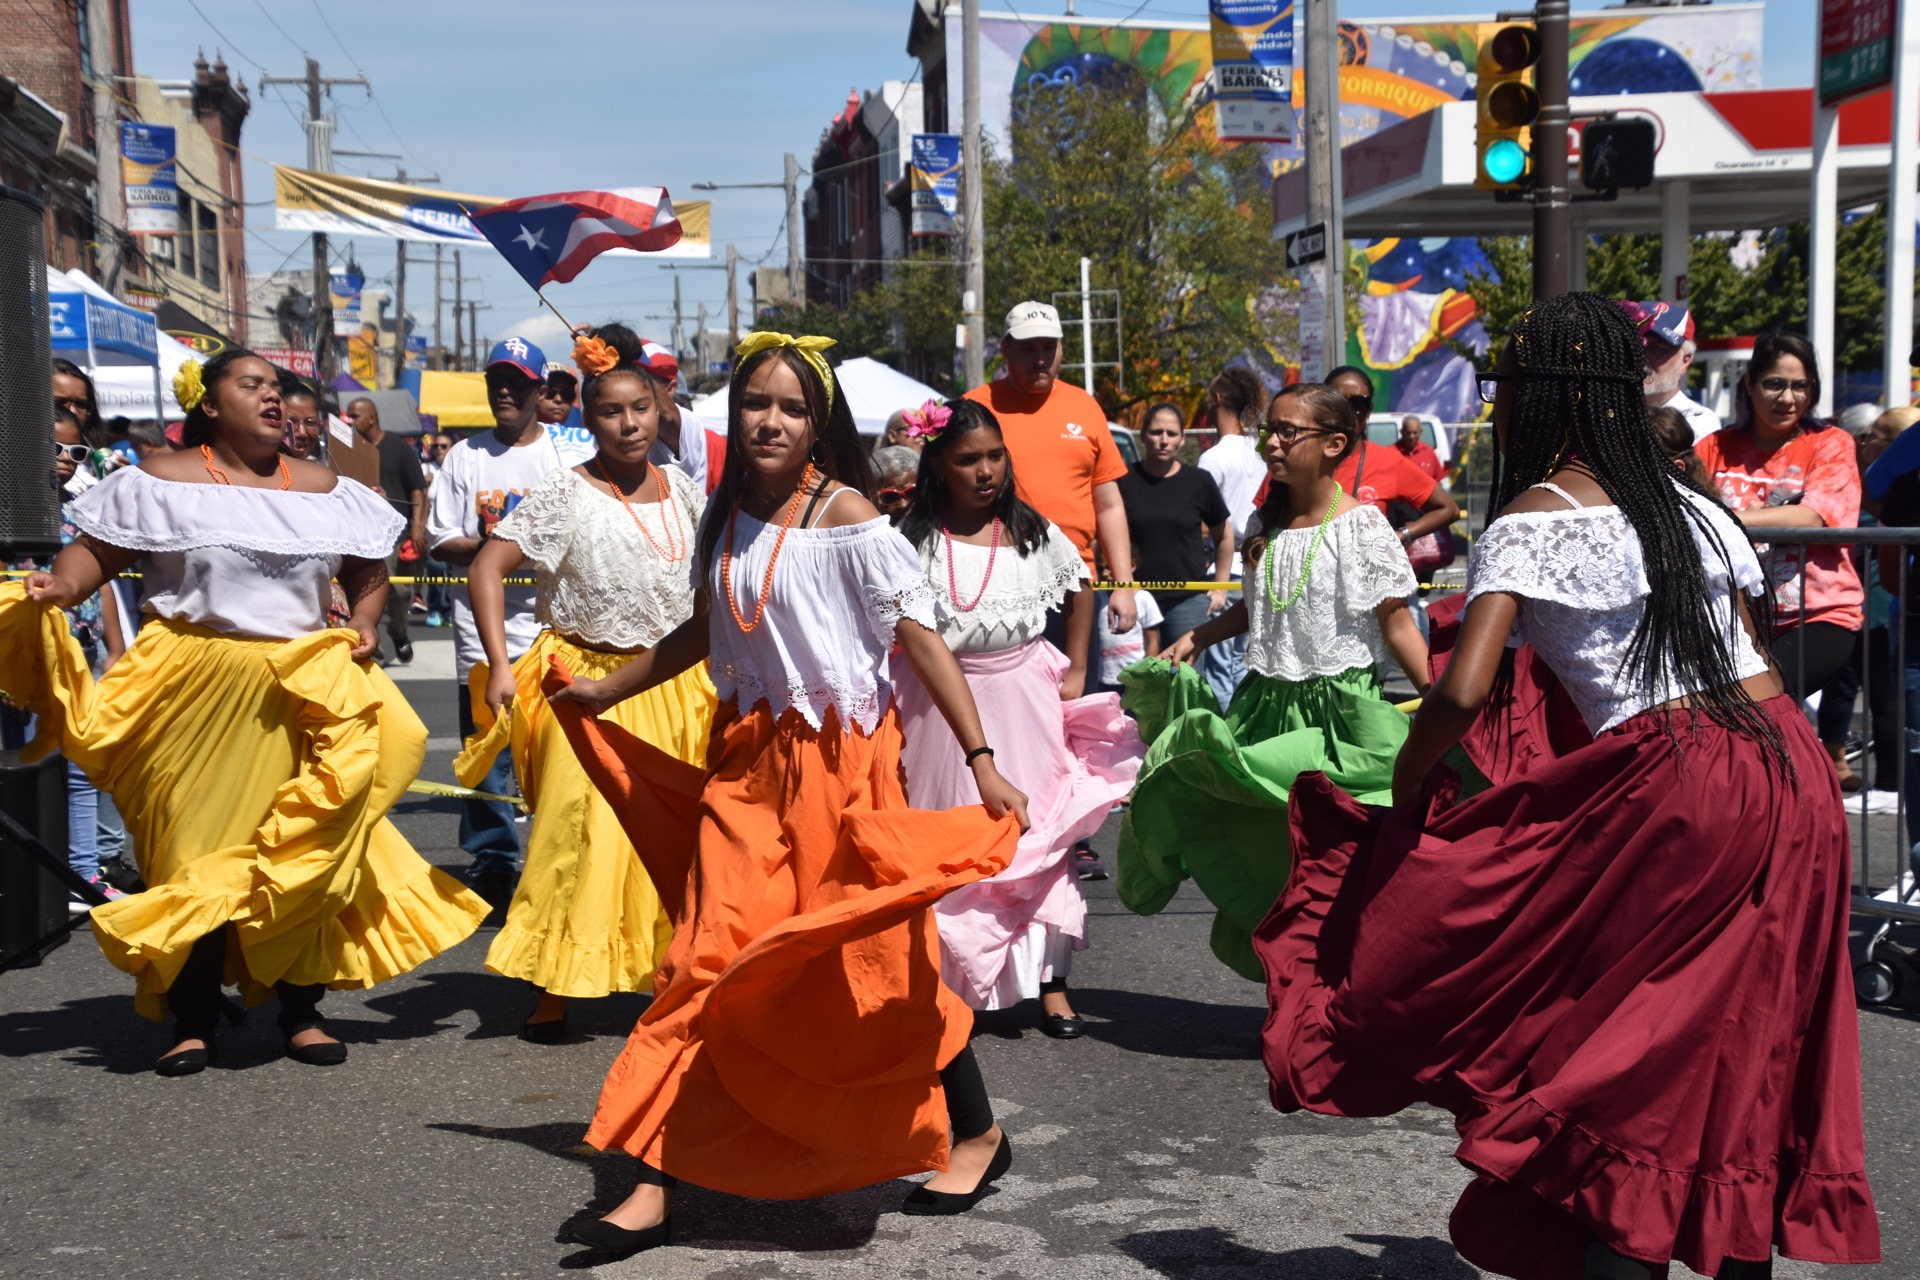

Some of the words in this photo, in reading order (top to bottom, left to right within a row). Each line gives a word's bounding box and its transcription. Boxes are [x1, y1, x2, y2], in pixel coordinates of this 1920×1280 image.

[1215, 4, 1278, 14] Community
[1217, 30, 1292, 40] Celebrando
[1217, 40, 1292, 49] Comunidad
[1222, 66, 1256, 75] FERIA
[1261, 68, 1283, 76] DEL
[1222, 76, 1283, 88] BARRIO
[412, 208, 471, 229] FERIA
